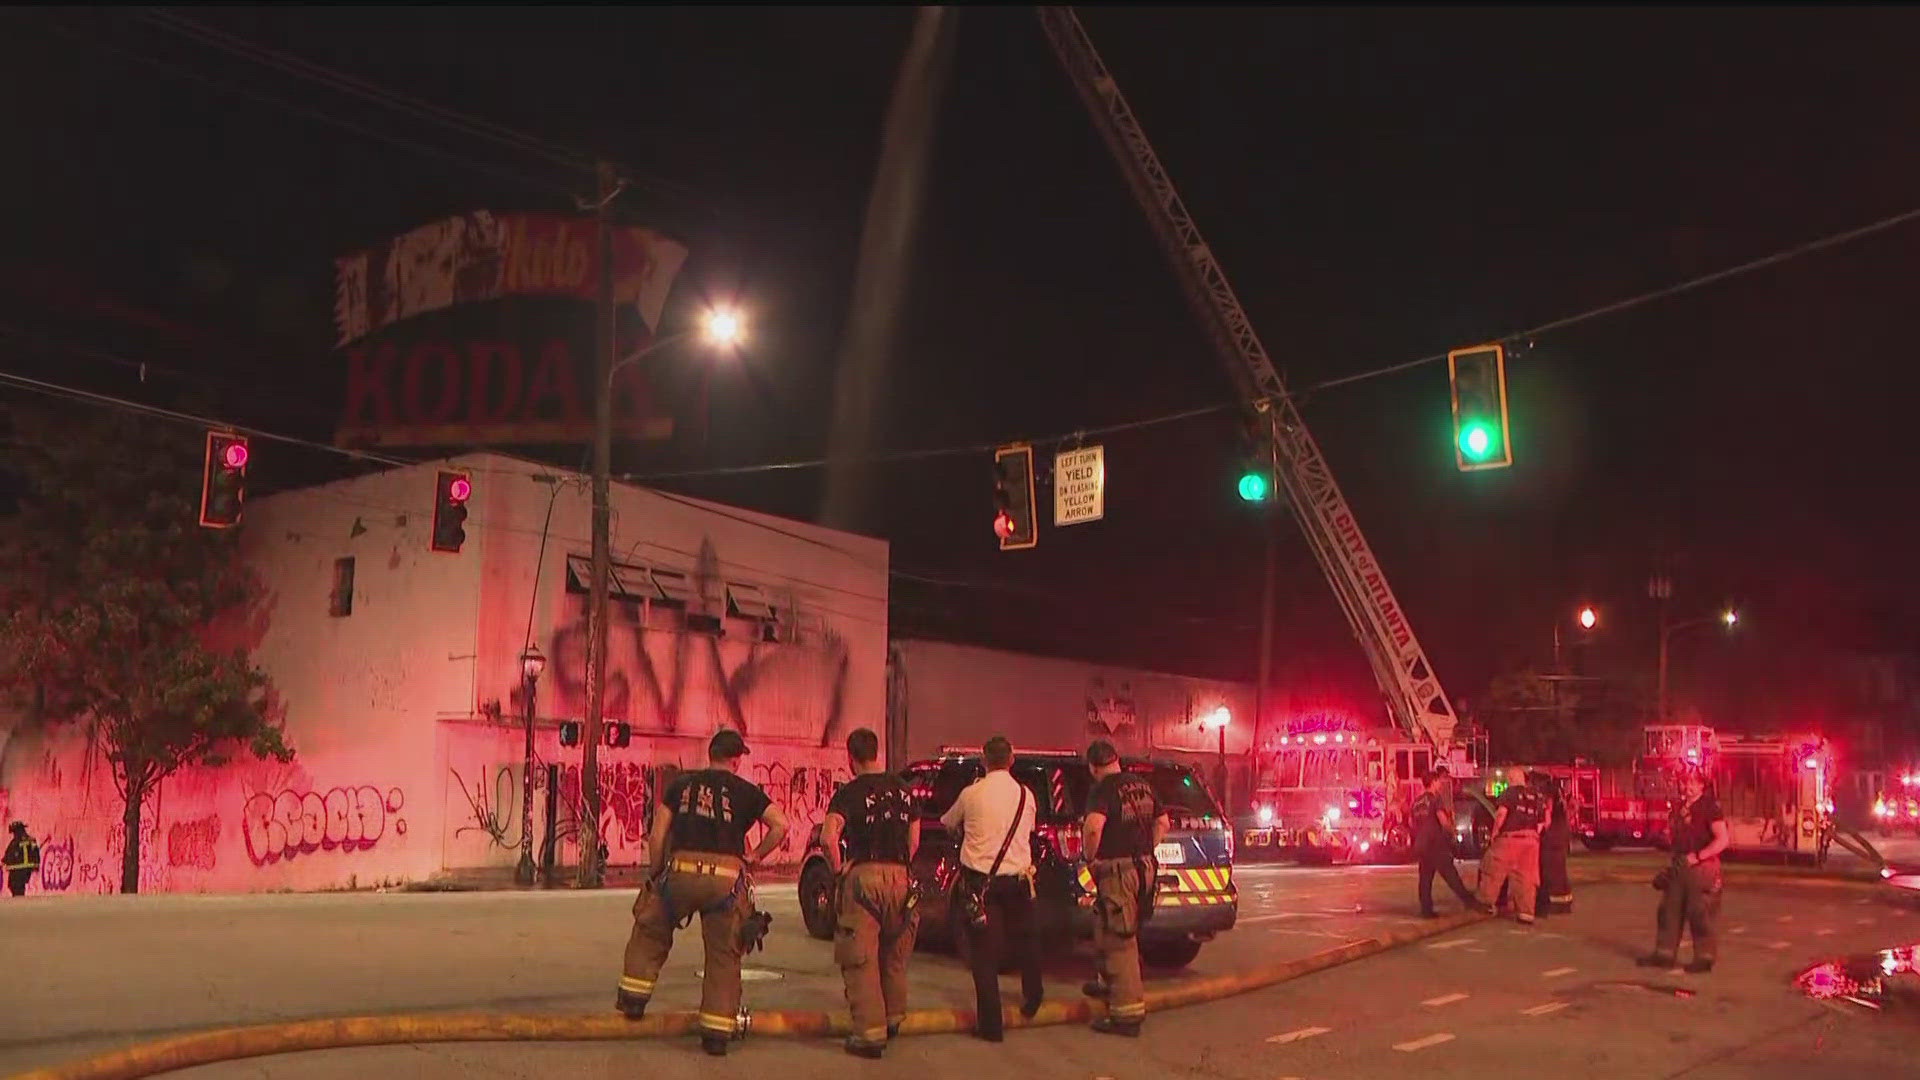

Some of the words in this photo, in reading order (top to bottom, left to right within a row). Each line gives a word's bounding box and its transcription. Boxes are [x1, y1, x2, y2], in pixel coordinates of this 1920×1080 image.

[344, 337, 660, 426] KODAK
[1061, 456, 1077, 467] LEFT
[1080, 453, 1097, 464] TURN
[1066, 467, 1093, 480] YIELD
[1060, 487, 1068, 496] ON
[1070, 480, 1098, 494] FLASHING
[1064, 494, 1095, 507] YELLOW
[1065, 506, 1093, 519] ARROW
[1335, 513, 1365, 554] CITY
[1358, 556, 1374, 570] of
[1365, 571, 1411, 648] ATLANTA
